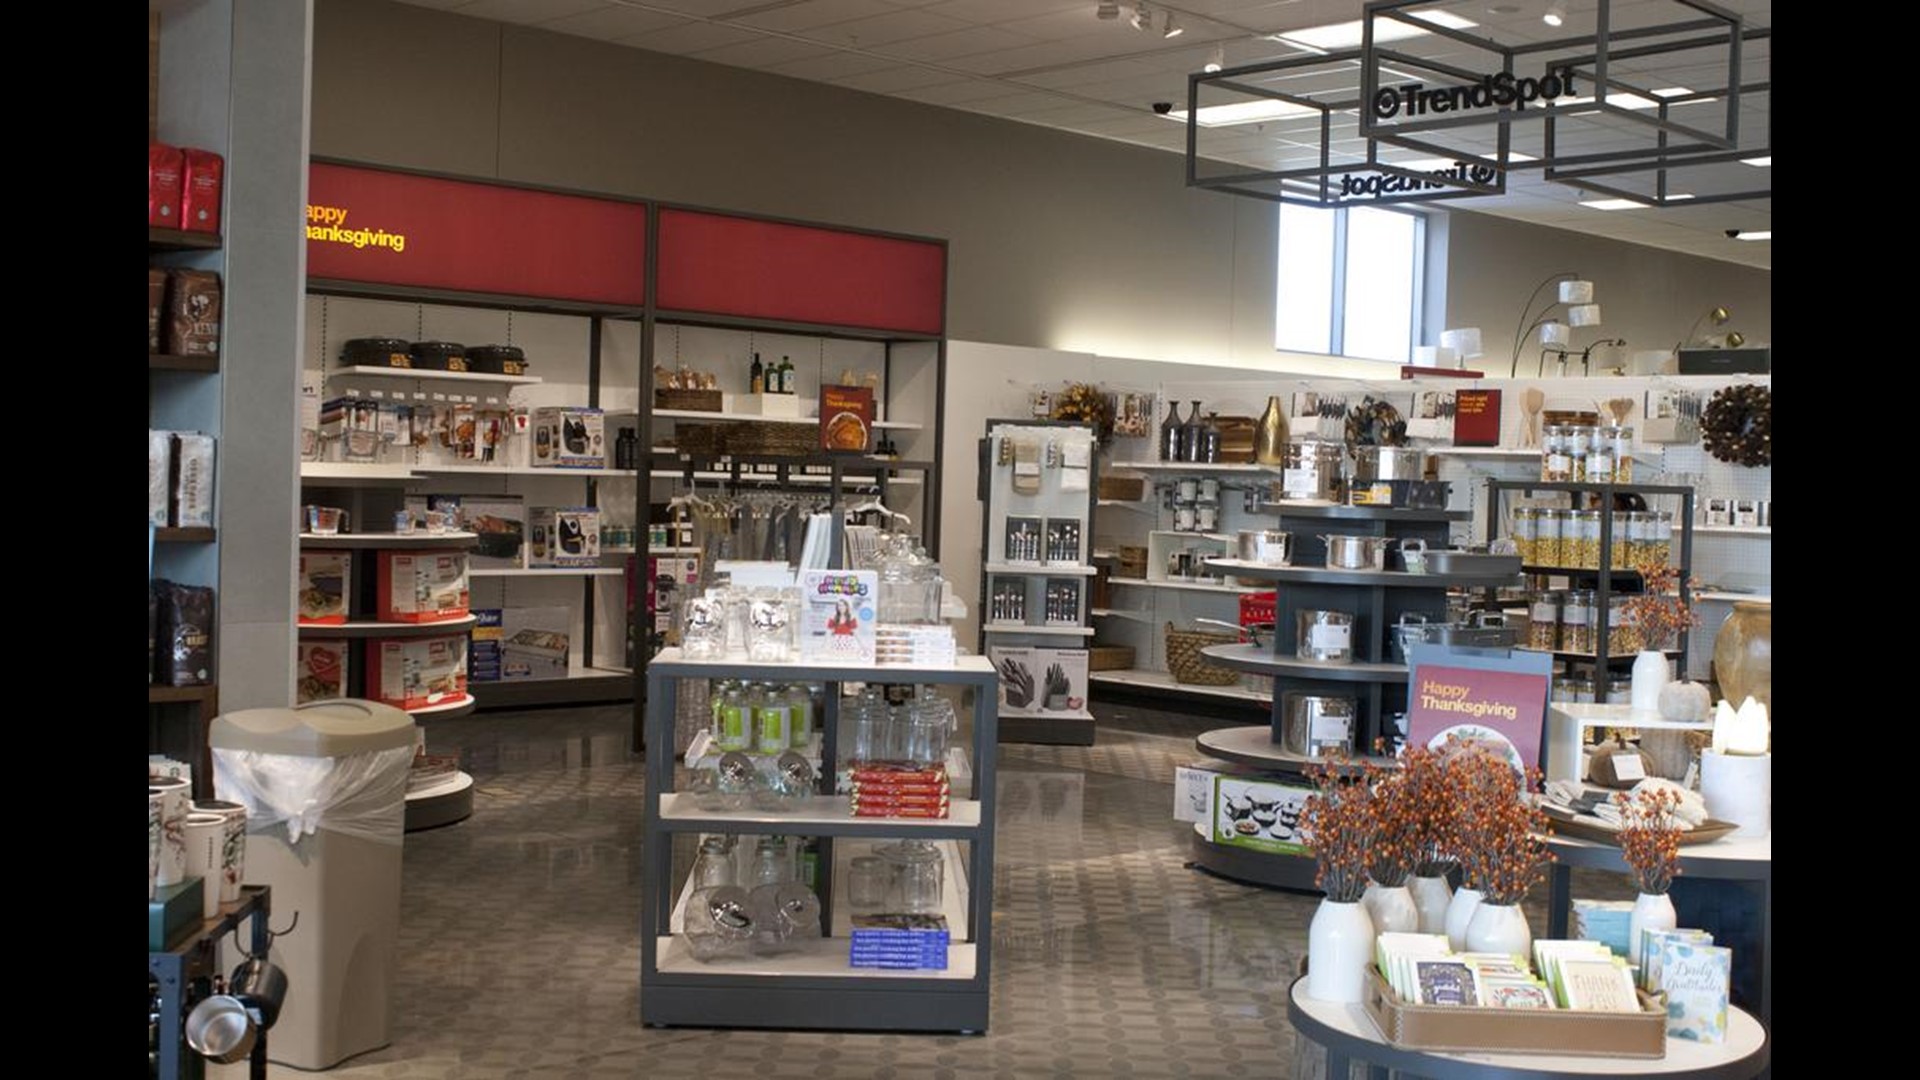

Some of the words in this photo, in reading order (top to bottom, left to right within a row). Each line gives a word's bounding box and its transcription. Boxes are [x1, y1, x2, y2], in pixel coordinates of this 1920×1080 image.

[1400, 68, 1577, 117] TrendSpot
[306, 204, 347, 225] appy
[306, 225, 405, 253] anksgiving
[1422, 679, 1471, 700] Happy
[1420, 694, 1518, 720] Thanksgiving
